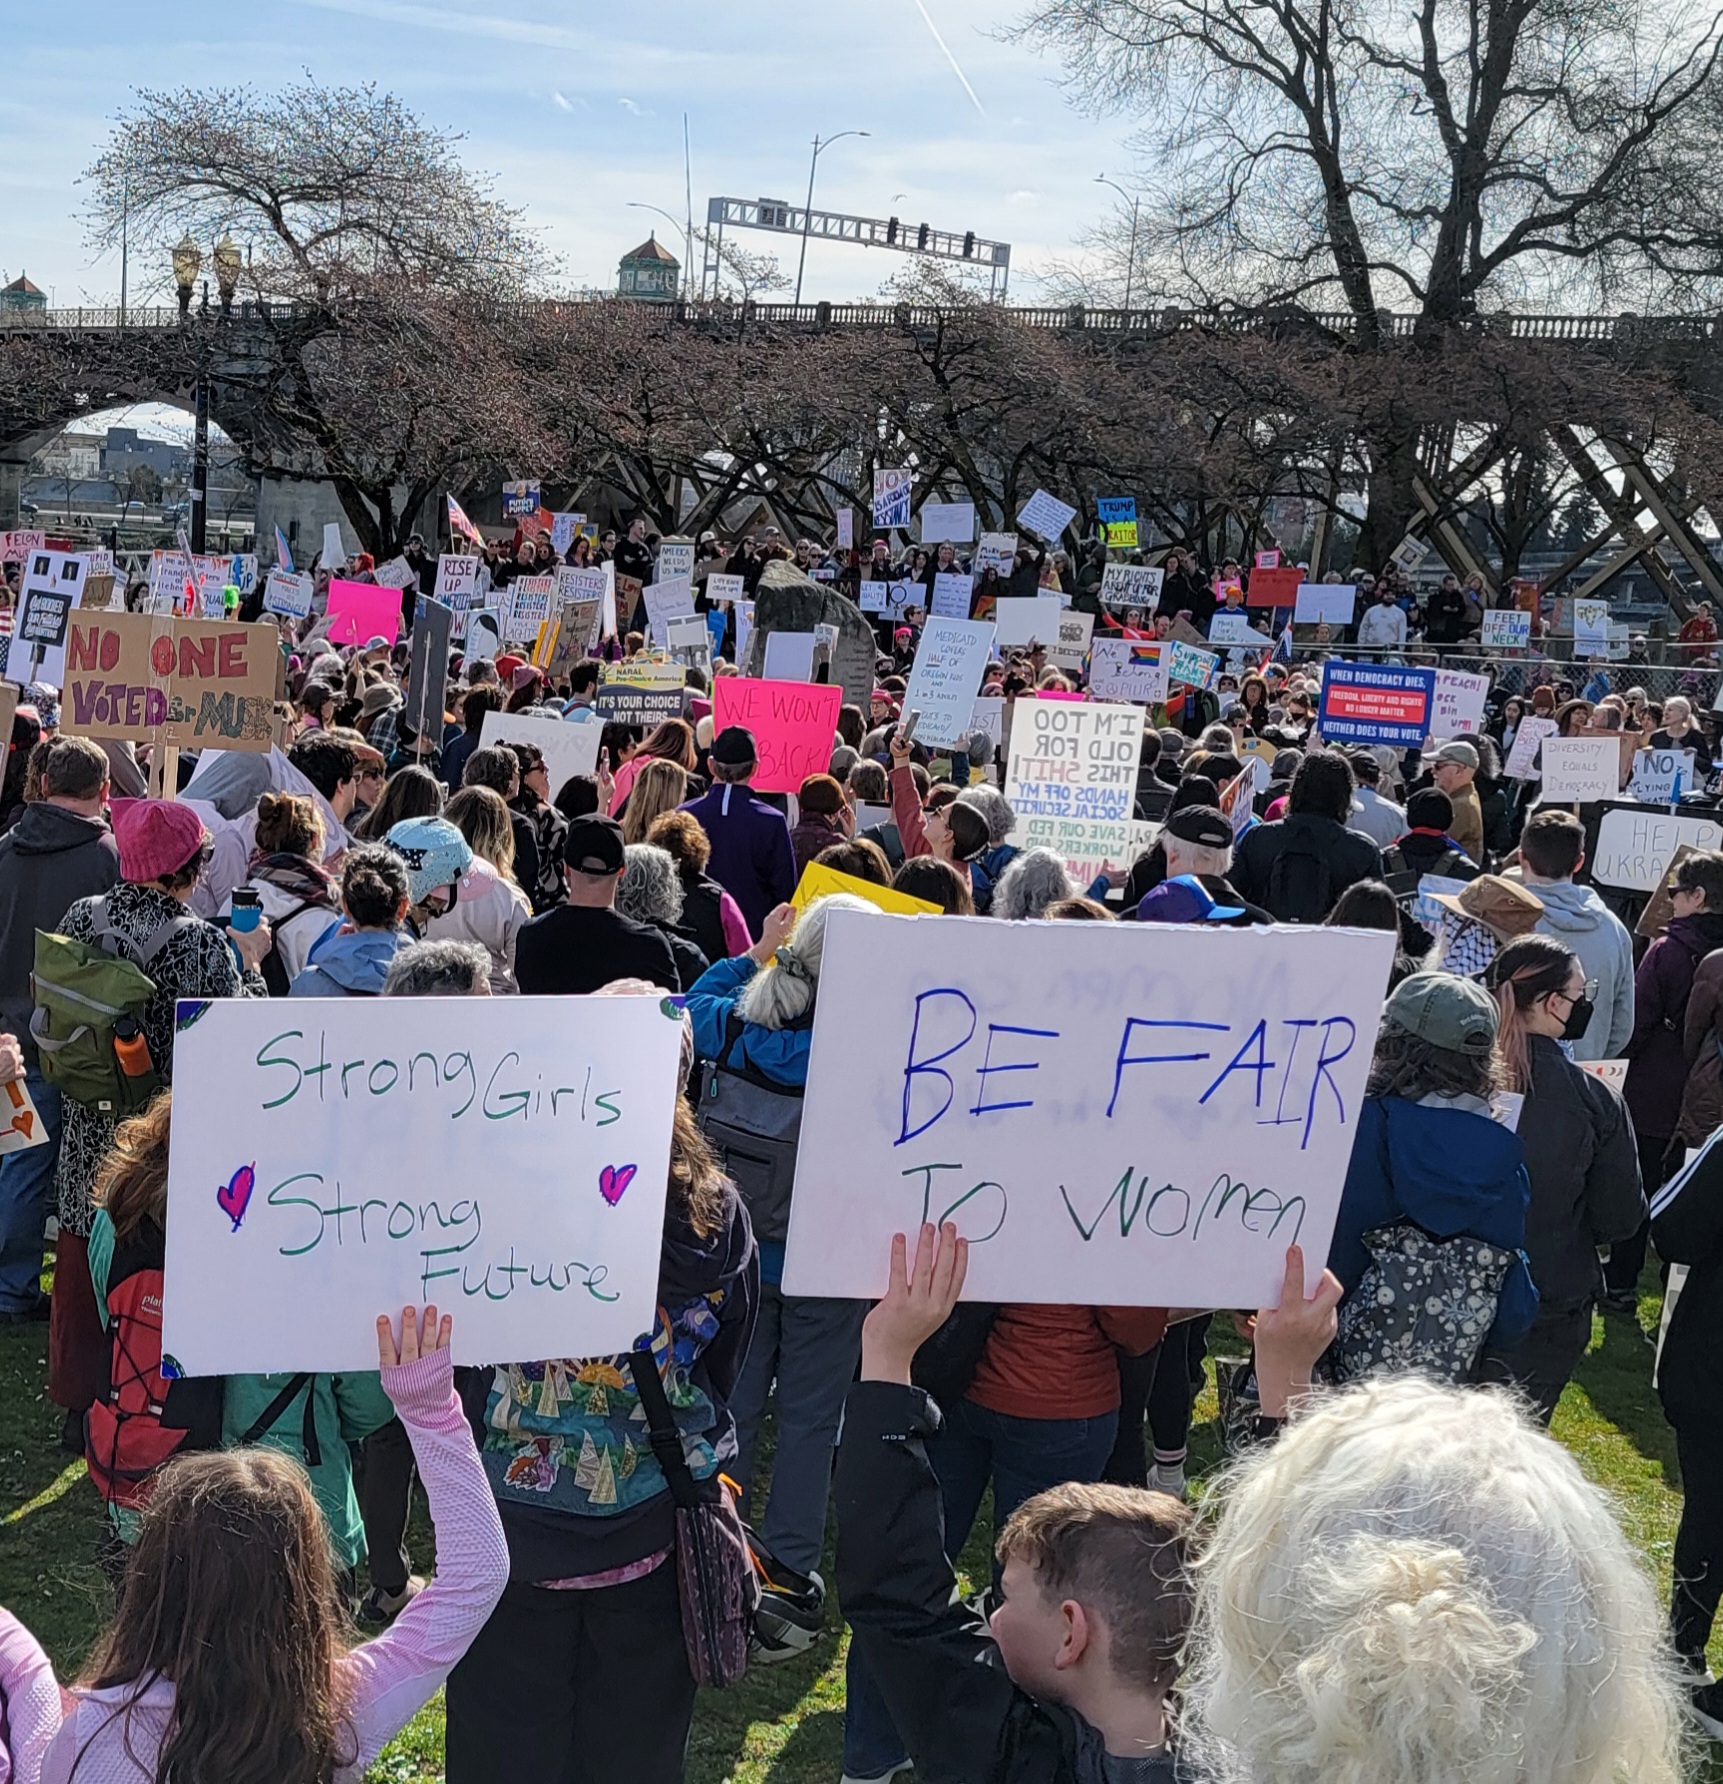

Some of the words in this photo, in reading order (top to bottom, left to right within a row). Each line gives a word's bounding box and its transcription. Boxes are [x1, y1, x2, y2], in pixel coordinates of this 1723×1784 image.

[1101, 501, 1133, 512] TRUMP
[1105, 515, 1117, 524] IS
[1124, 515, 1131, 524] A
[6, 533, 40, 547] FELON
[5, 548, 30, 559] MUS
[444, 560, 473, 576] RISE
[663, 558, 685, 566] NEEDS
[560, 572, 605, 589] RESISTERS
[1105, 568, 1123, 580] MY
[1123, 570, 1156, 584] RIGHTS
[444, 579, 461, 592] UP
[1142, 584, 1159, 597] FOR
[1494, 612, 1522, 624] FEET
[1484, 623, 1505, 633] OFF
[1509, 624, 1529, 634] OUR
[935, 630, 977, 646] MEDICAID
[1492, 634, 1520, 645] NECK
[68, 624, 120, 672] NO
[150, 633, 248, 678] ONE
[941, 644, 967, 656] COVERS
[1093, 641, 1116, 658] We
[1174, 643, 1215, 668] SUPPORT
[927, 653, 945, 664] HALF
[948, 657, 961, 667] OF
[921, 668, 948, 680] OREGON
[949, 671, 963, 681] KIDS
[1106, 661, 1164, 687] Belong
[1330, 669, 1352, 682] WHEN
[1354, 671, 1403, 686] DEMOCRACY
[1405, 675, 1426, 689] DIES,
[599, 696, 615, 708] IT'S
[617, 696, 643, 708] YOUR
[644, 696, 681, 708] CHOICE
[928, 691, 934, 699] 3
[1330, 690, 1360, 702] FREEDOM,
[1361, 693, 1385, 703] LIBERTY
[1386, 696, 1399, 705] AND
[1400, 697, 1422, 706] RIGHTS
[1436, 693, 1457, 703] OCK
[719, 685, 762, 721] WE
[772, 692, 838, 727] WON'T
[1345, 704, 1354, 713] NO
[1355, 705, 1378, 715] LONGER
[1380, 707, 1406, 718] MATTER.
[916, 721, 951, 734] EDICAID/
[1323, 721, 1355, 735] NEITHER
[1356, 724, 1377, 737] DOES
[1379, 725, 1399, 739] YOUR
[1400, 727, 1423, 742] VOTE.
[758, 745, 831, 779] BACK!
[1563, 761, 1598, 772] EQUALS
[1643, 755, 1674, 775] NO
[1548, 774, 1615, 797] DEMOCRACY!
[1637, 783, 1671, 793] LYING
[893, 987, 1060, 1147] BE
[1106, 1015, 1357, 1151] FAIR
[256, 1029, 477, 1120] Strong
[482, 1051, 622, 1127] Girls
[267, 1173, 482, 1257] Strong
[419, 1245, 621, 1304] Future
